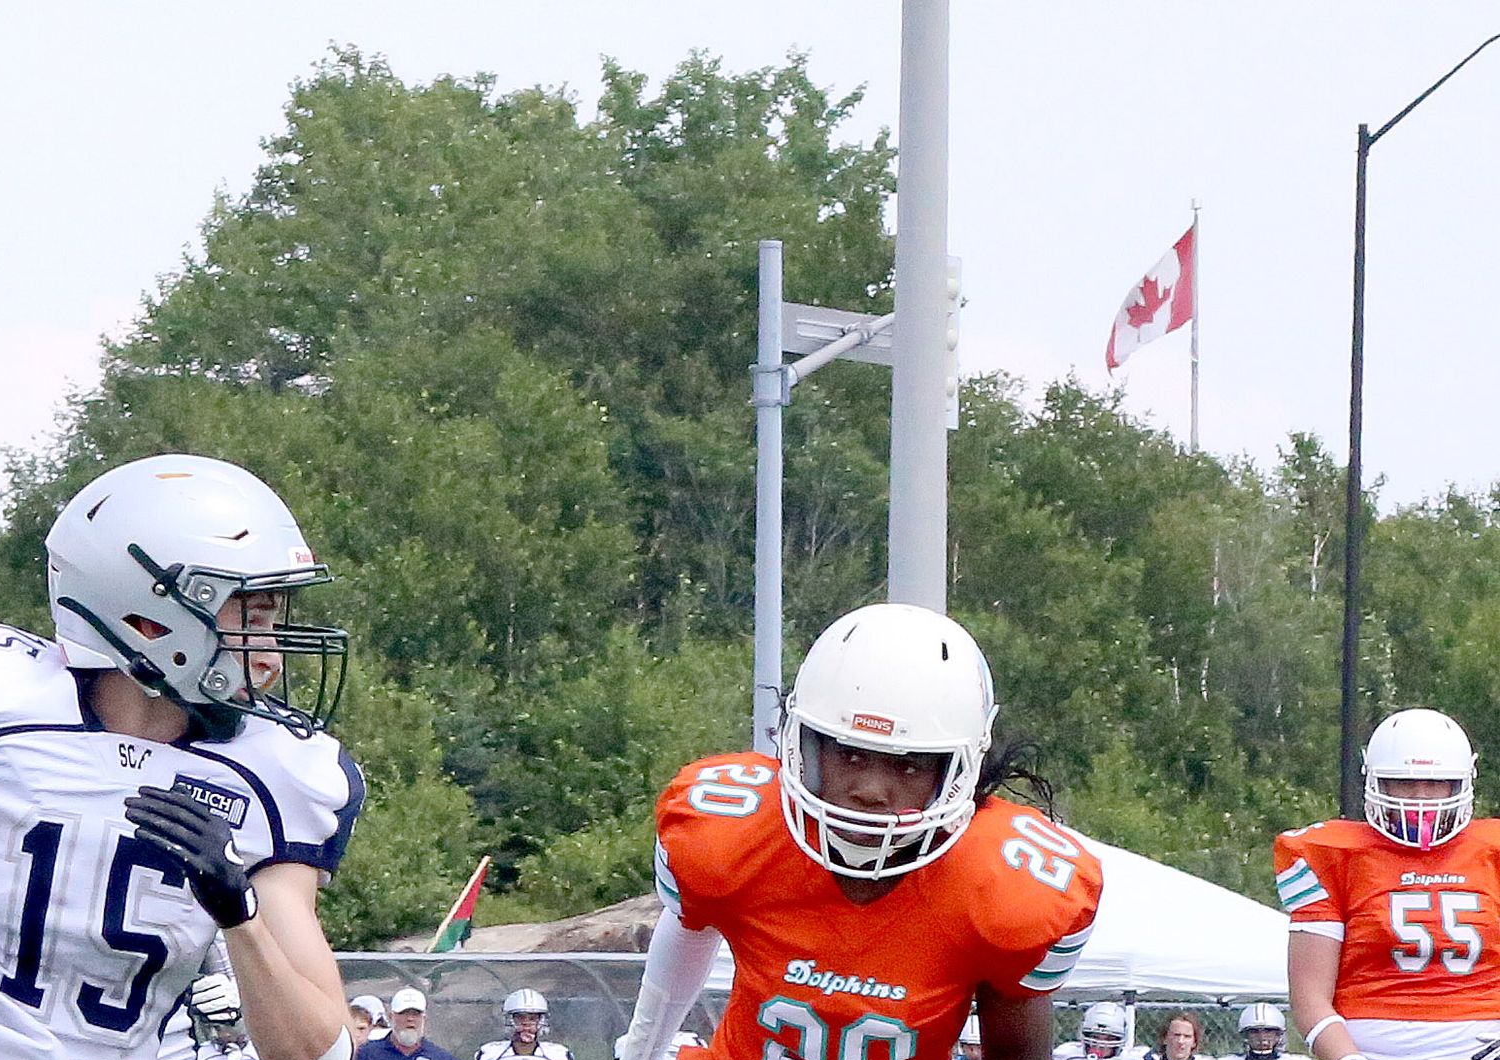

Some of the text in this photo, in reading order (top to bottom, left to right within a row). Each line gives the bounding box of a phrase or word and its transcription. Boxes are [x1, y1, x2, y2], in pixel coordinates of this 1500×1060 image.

[854, 716, 891, 731] PHINS
[687, 763, 775, 818] 20
[1001, 813, 1080, 893] 20
[1400, 871, 1466, 886] Dolphins
[0, 820, 187, 1033] 15
[1388, 890, 1483, 975] 55
[783, 958, 908, 1001] Dolphins
